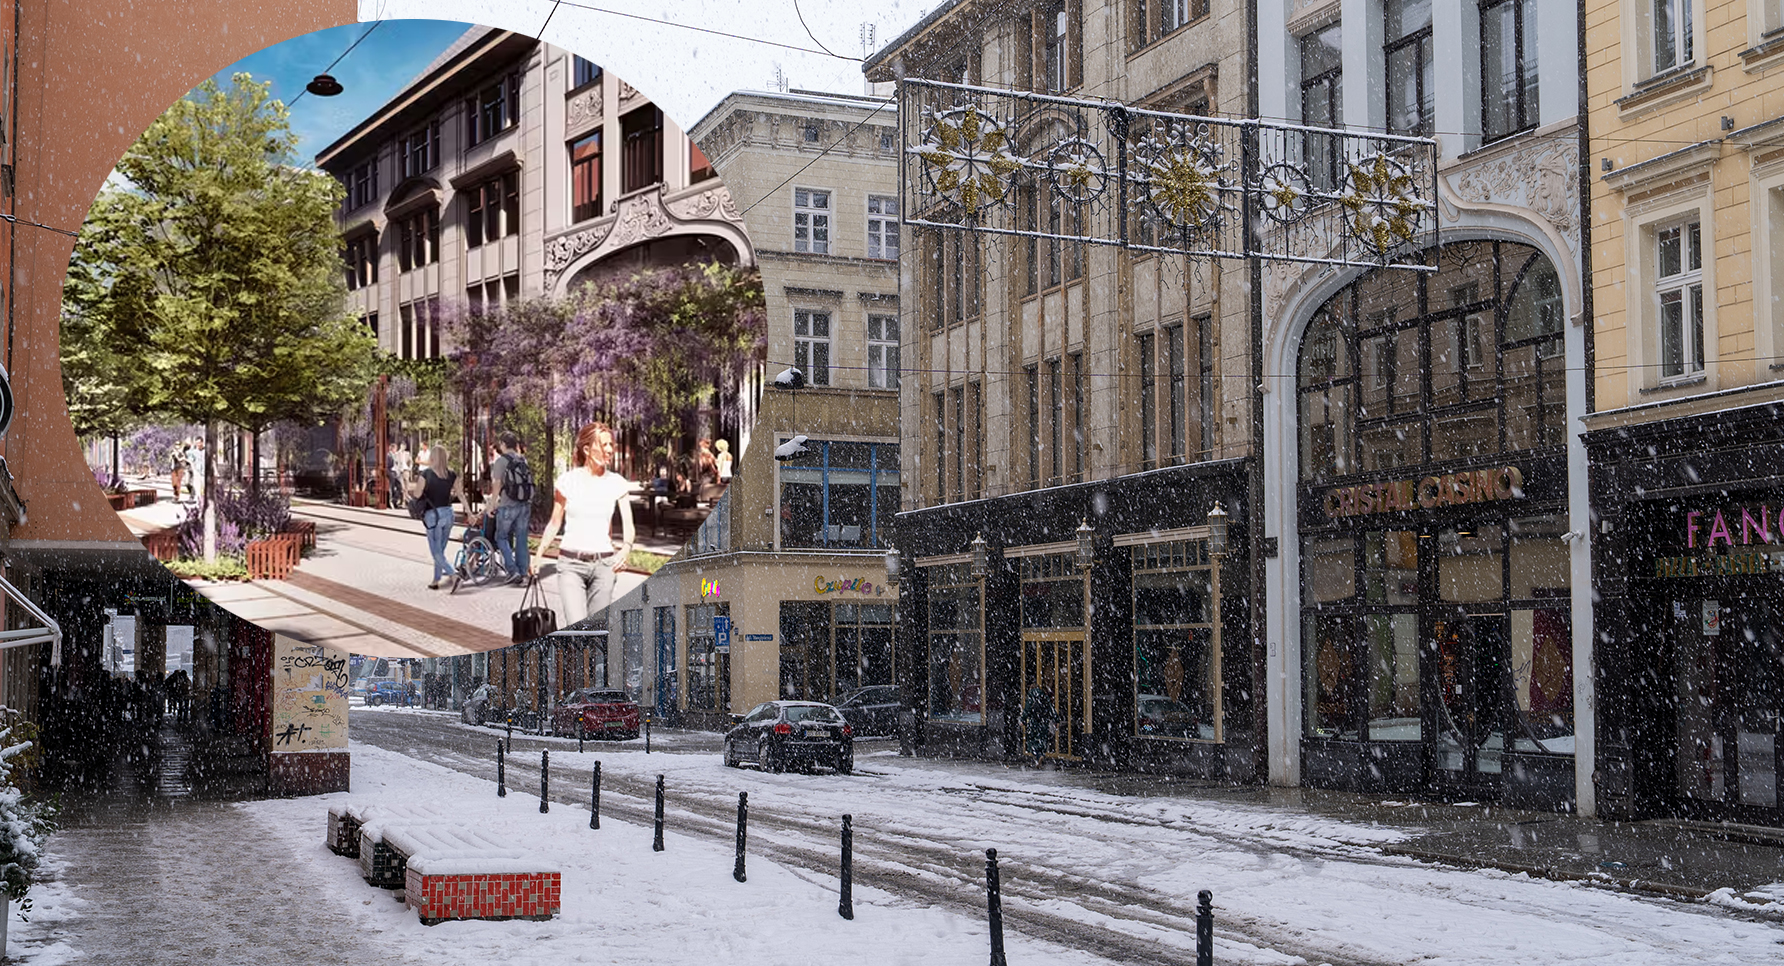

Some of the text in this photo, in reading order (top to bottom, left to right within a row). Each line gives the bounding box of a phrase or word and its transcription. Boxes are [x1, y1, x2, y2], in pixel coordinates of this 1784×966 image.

[1324, 465, 1522, 518] CRISTAL CASINO
[1687, 504, 1784, 549] FAN
[1653, 552, 1766, 578] PIZZA PASTA
[814, 574, 873, 595] Czupito
[718, 632, 728, 645] P
